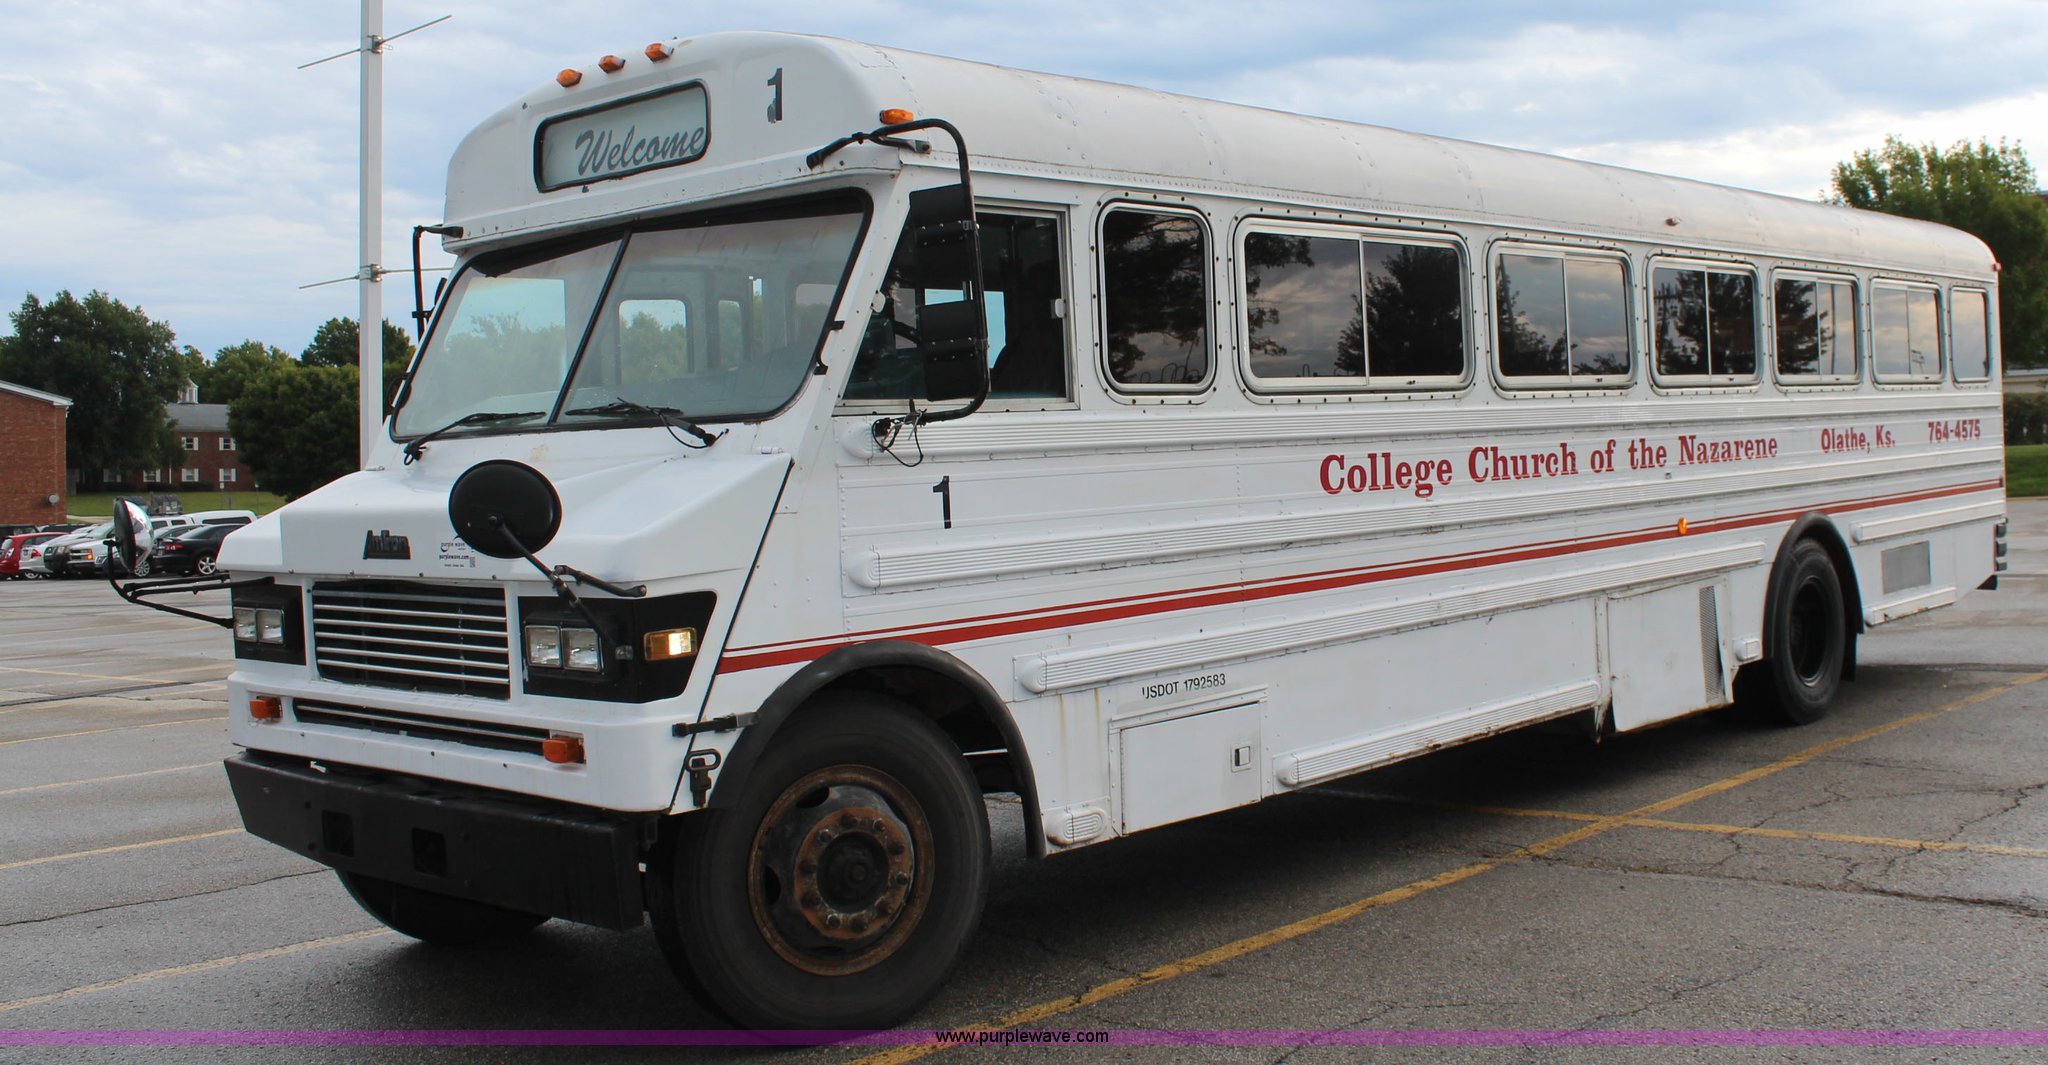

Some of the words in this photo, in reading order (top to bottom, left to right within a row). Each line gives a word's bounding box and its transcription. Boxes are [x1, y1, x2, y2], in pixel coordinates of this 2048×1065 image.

[767, 67, 783, 123] 1
[575, 125, 705, 176] Welcome
[1821, 427, 1870, 453] Olathe,
[1876, 425, 1895, 448] Ks.
[1928, 419, 1981, 443] 764-4575
[1319, 452, 1453, 498] College
[1468, 442, 1579, 483] Church
[1590, 439, 1617, 473] of
[1628, 438, 1667, 469] the
[1678, 435, 1778, 465] Nazarene
[933, 476, 951, 529] 1
[1142, 681, 1179, 699] USDOT
[1184, 673, 1226, 691] 1792583
